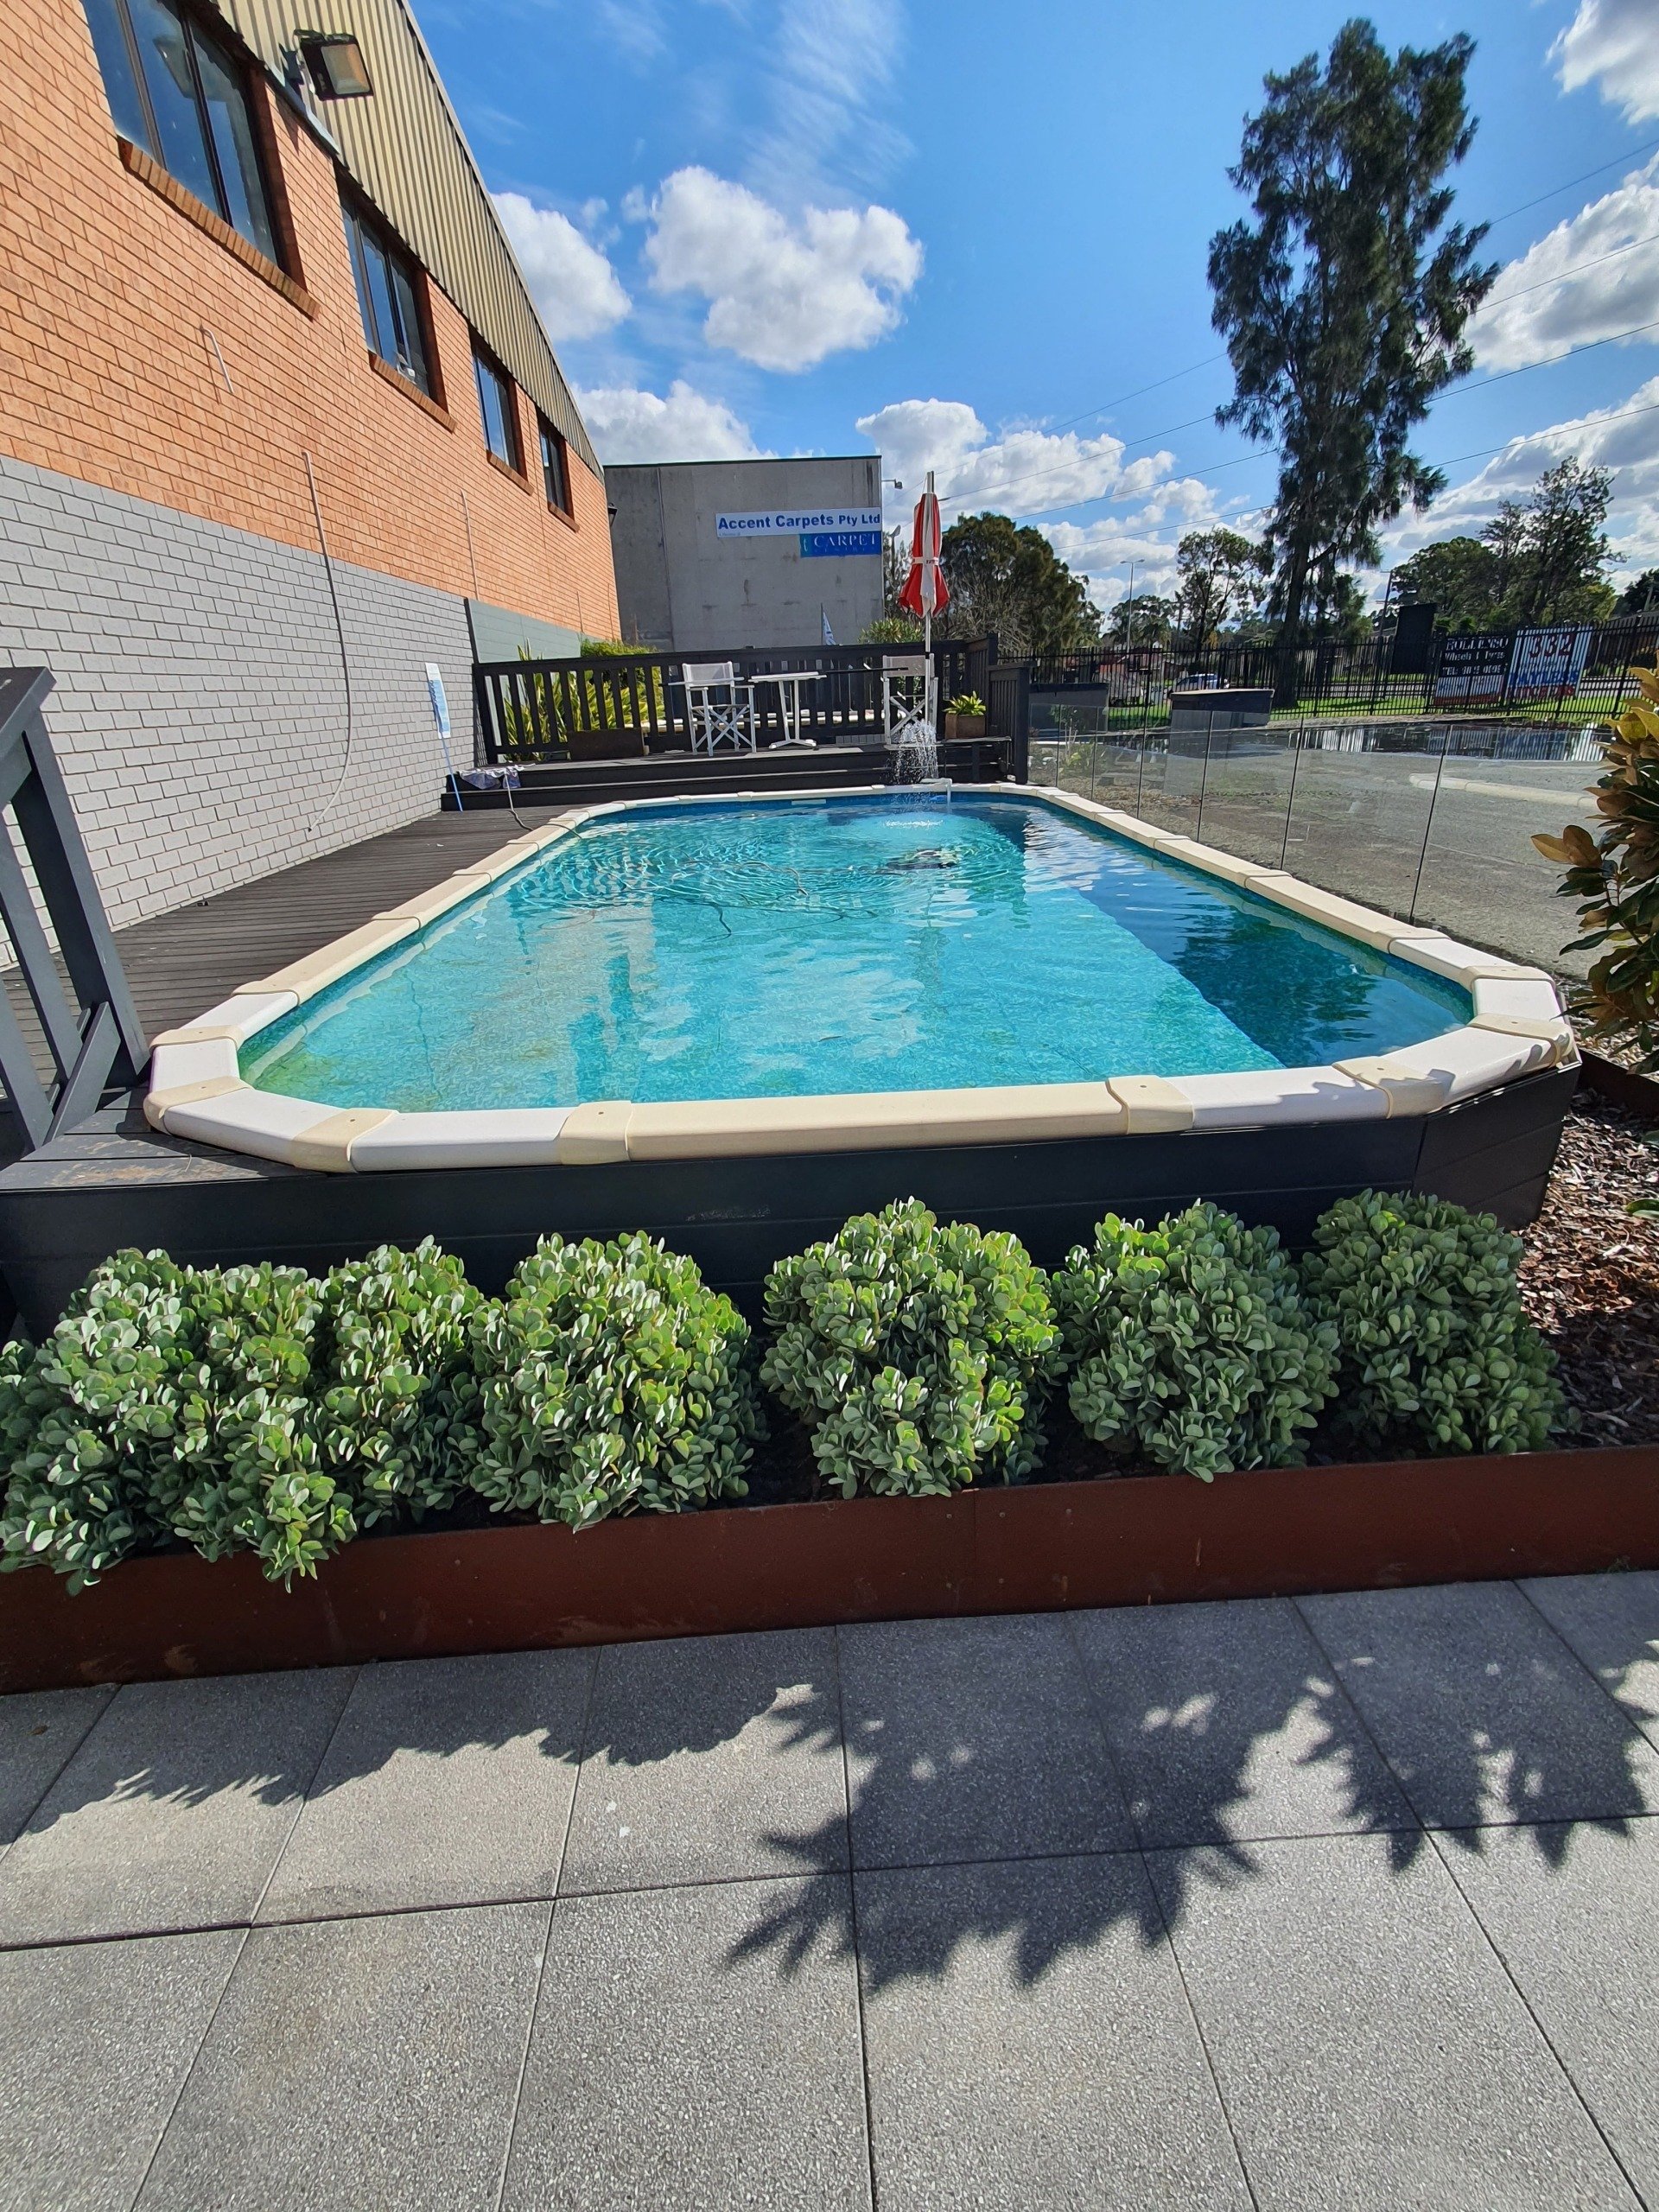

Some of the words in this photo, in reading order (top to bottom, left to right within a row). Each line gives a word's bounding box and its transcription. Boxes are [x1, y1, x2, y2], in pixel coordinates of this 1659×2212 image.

[718, 517, 771, 530] Accent
[775, 513, 834, 530] Carpets
[838, 514, 858, 526] Pty
[861, 513, 880, 524] Ltd
[813, 533, 876, 547] CARPET
